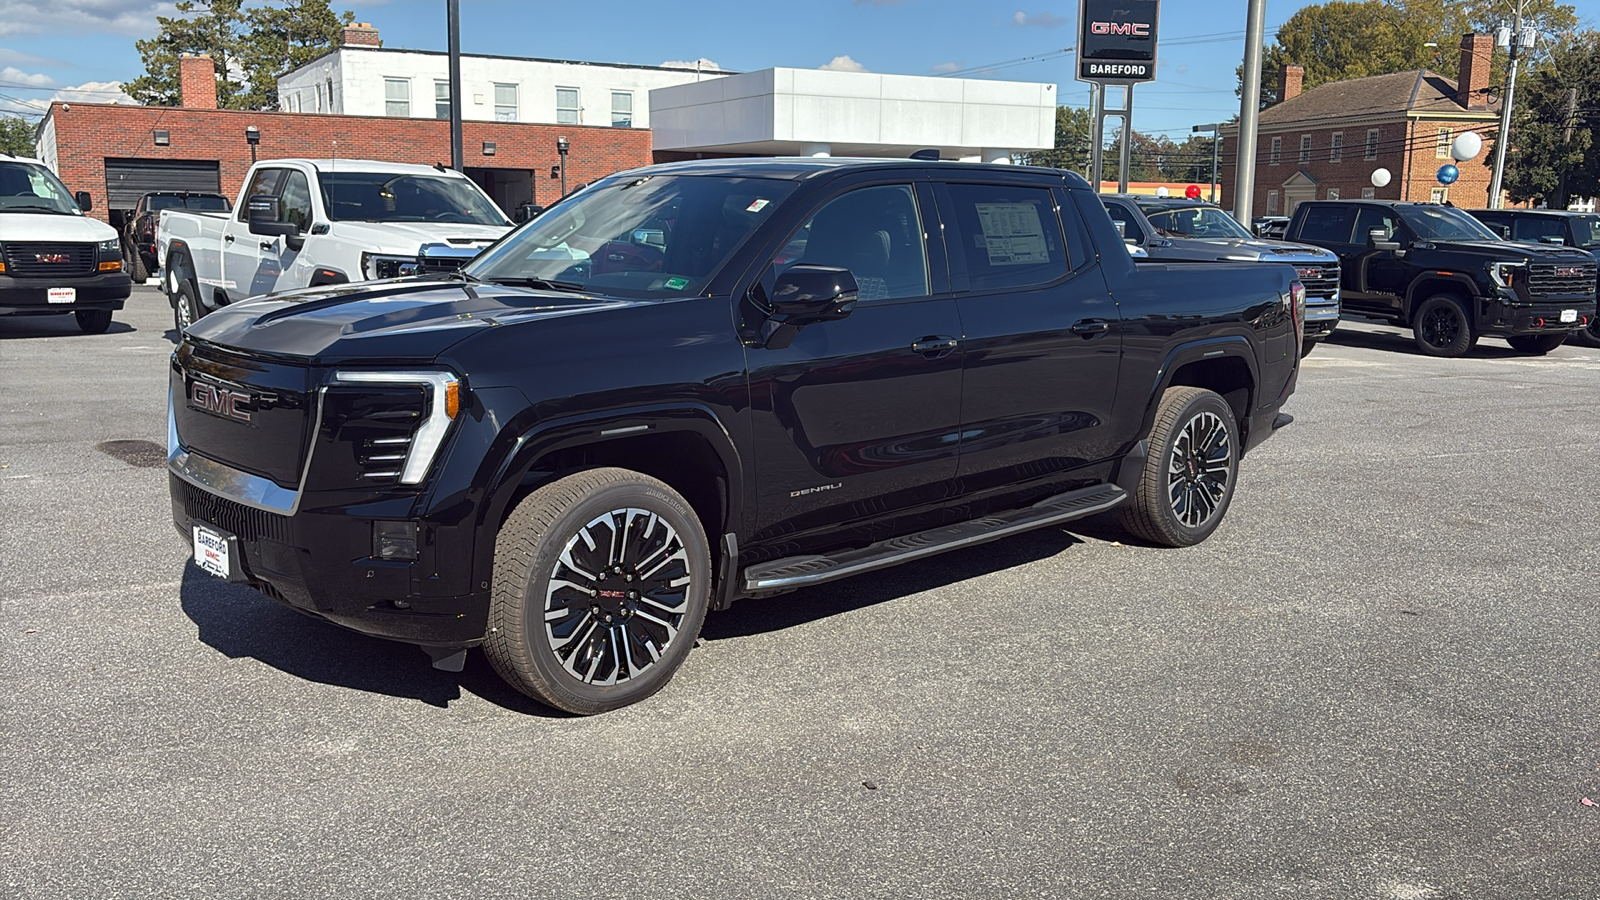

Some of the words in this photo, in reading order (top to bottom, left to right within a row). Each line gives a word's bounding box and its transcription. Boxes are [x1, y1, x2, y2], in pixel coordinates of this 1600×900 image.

[1091, 21, 1149, 35] GMC
[1090, 64, 1146, 75] BAREFORD
[192, 381, 251, 421] GMC
[790, 482, 842, 497] DENALI
[646, 487, 687, 516] BRIDGESTONE
[198, 531, 226, 554] BAREFORD
[205, 549, 220, 562] GMC
